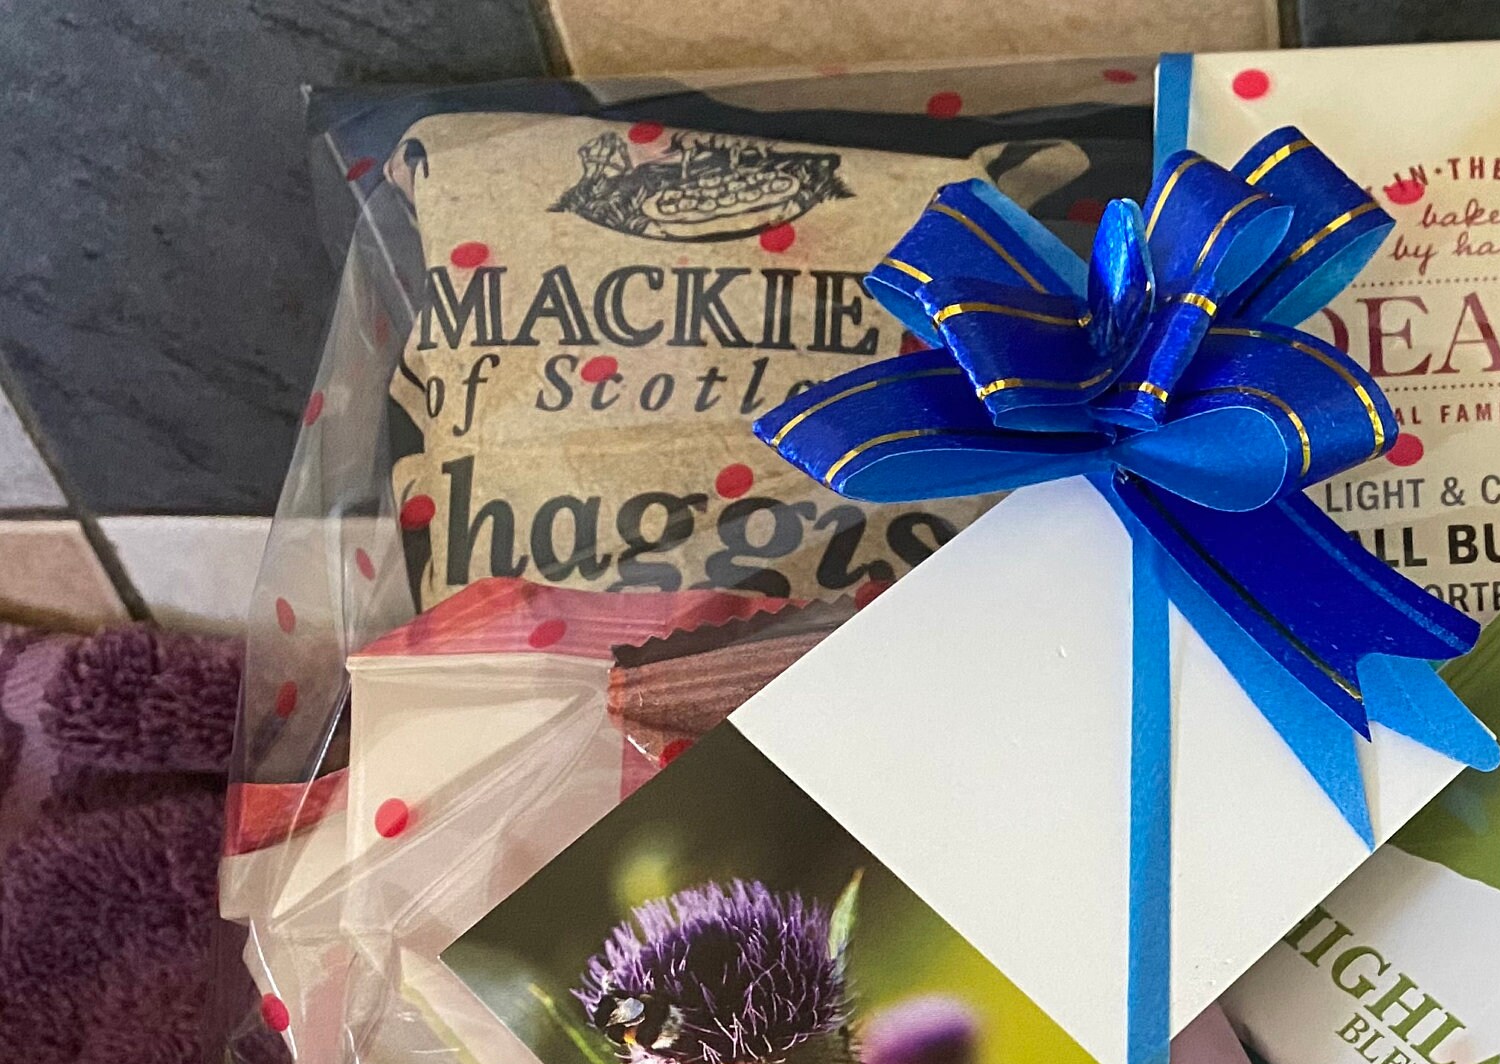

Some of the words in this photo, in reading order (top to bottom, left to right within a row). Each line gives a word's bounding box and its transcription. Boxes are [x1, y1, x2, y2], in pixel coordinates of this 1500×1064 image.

[1388, 234, 1438, 277] by
[416, 263, 879, 356] MACKIE
[426, 353, 500, 436] of
[535, 354, 822, 413] Scotl
[1324, 478, 1426, 513] LIGHT
[1440, 476, 1467, 507] &
